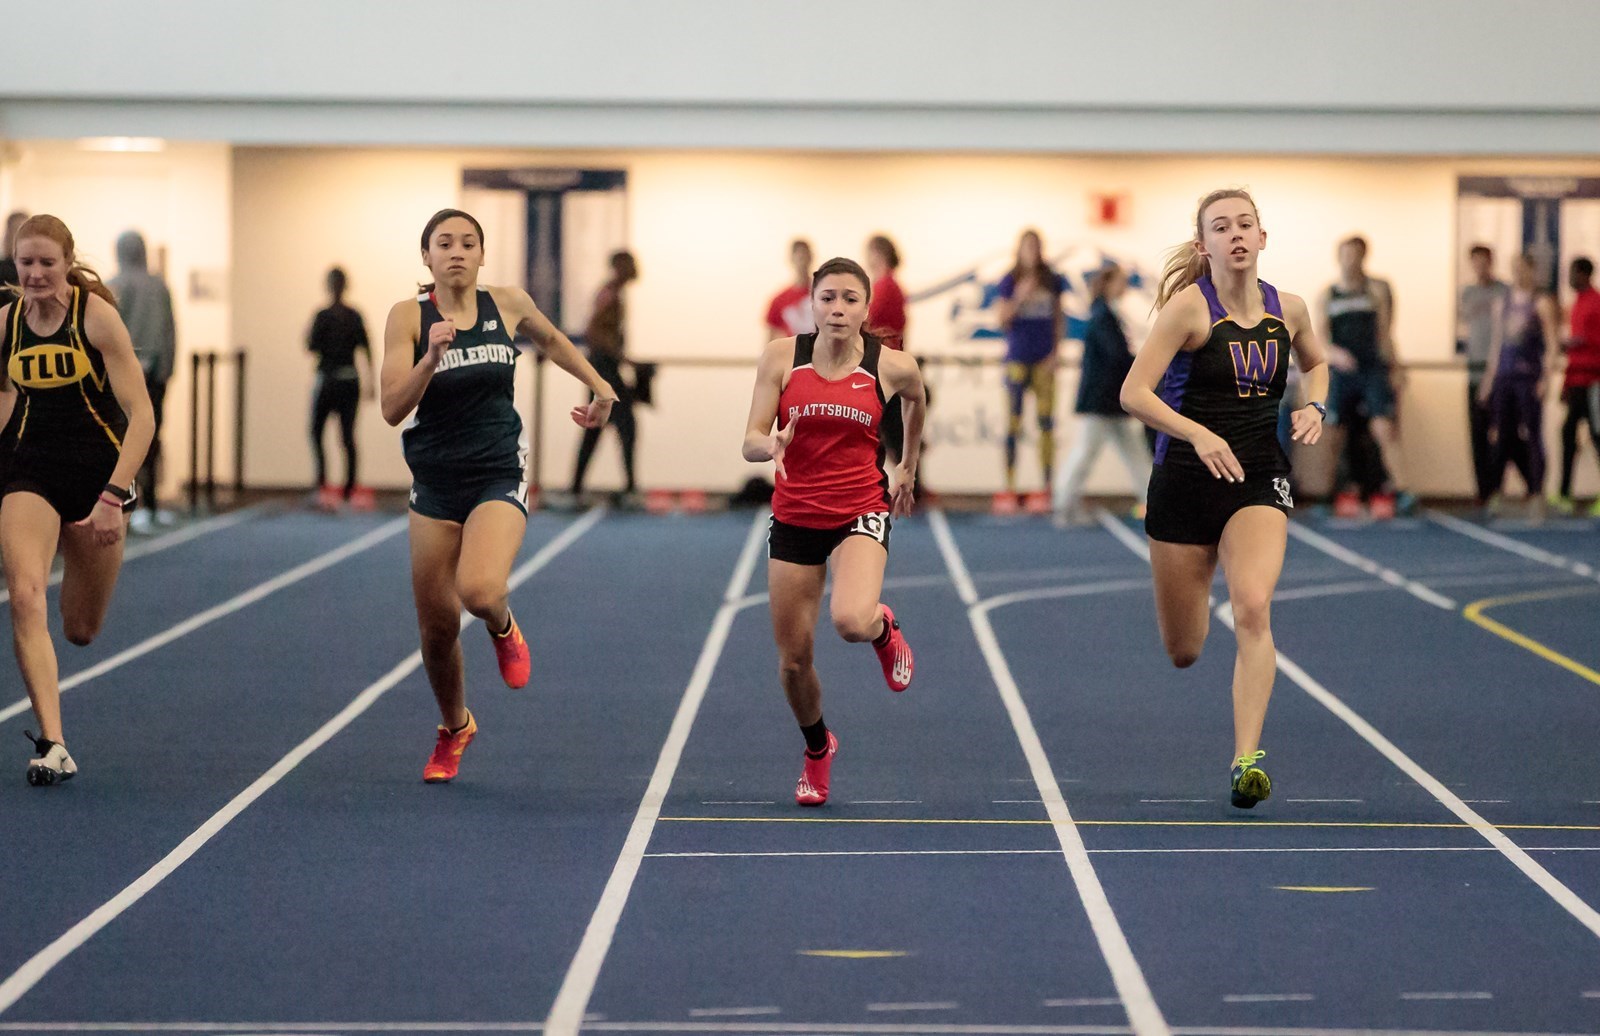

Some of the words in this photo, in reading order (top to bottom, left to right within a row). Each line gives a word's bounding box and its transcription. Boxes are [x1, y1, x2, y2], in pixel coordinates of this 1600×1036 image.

[18, 352, 76, 381] TLU
[434, 343, 515, 373] DDLEBURY
[1229, 339, 1278, 397] W
